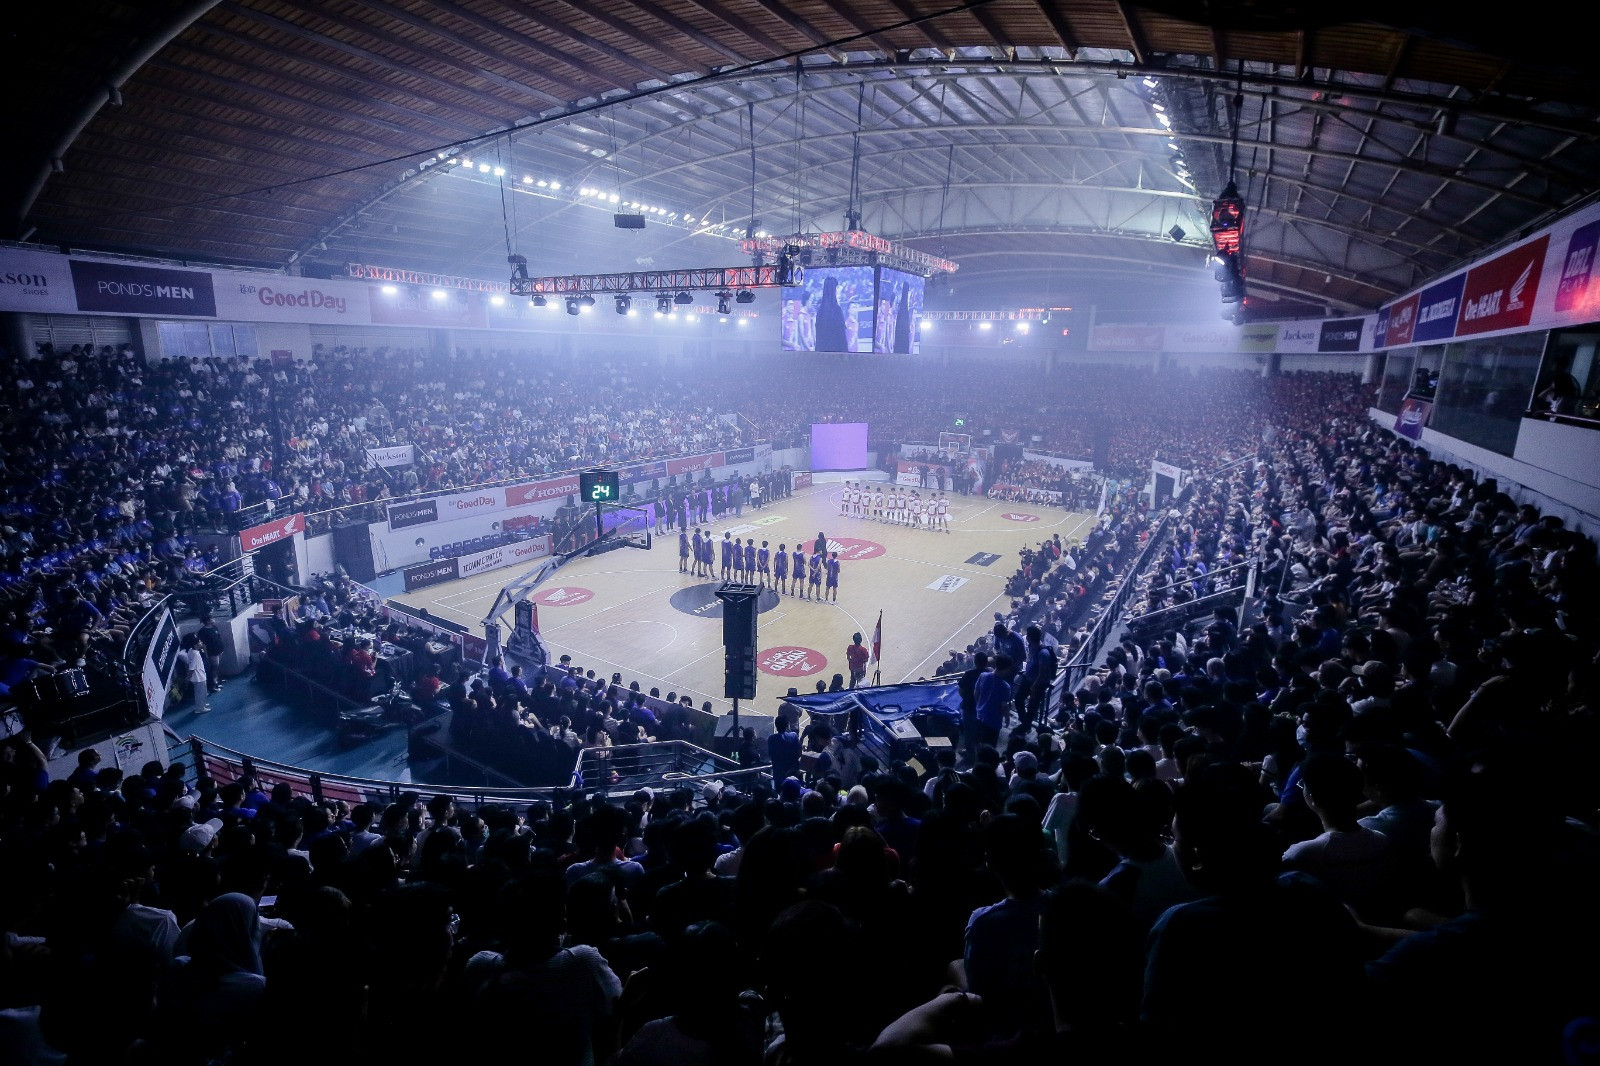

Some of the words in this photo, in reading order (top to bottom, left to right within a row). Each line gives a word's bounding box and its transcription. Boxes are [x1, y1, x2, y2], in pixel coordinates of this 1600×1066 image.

[1564, 246, 1593, 279] DBL
[156, 286, 195, 300] MEN
[1479, 289, 1503, 317] HEART
[537, 482, 580, 497] HONDA
[592, 485, 610, 499] 24
[417, 508, 434, 517] MEN
[251, 536, 263, 546] One
[262, 530, 281, 542] HEART
[437, 566, 453, 576] MEN
